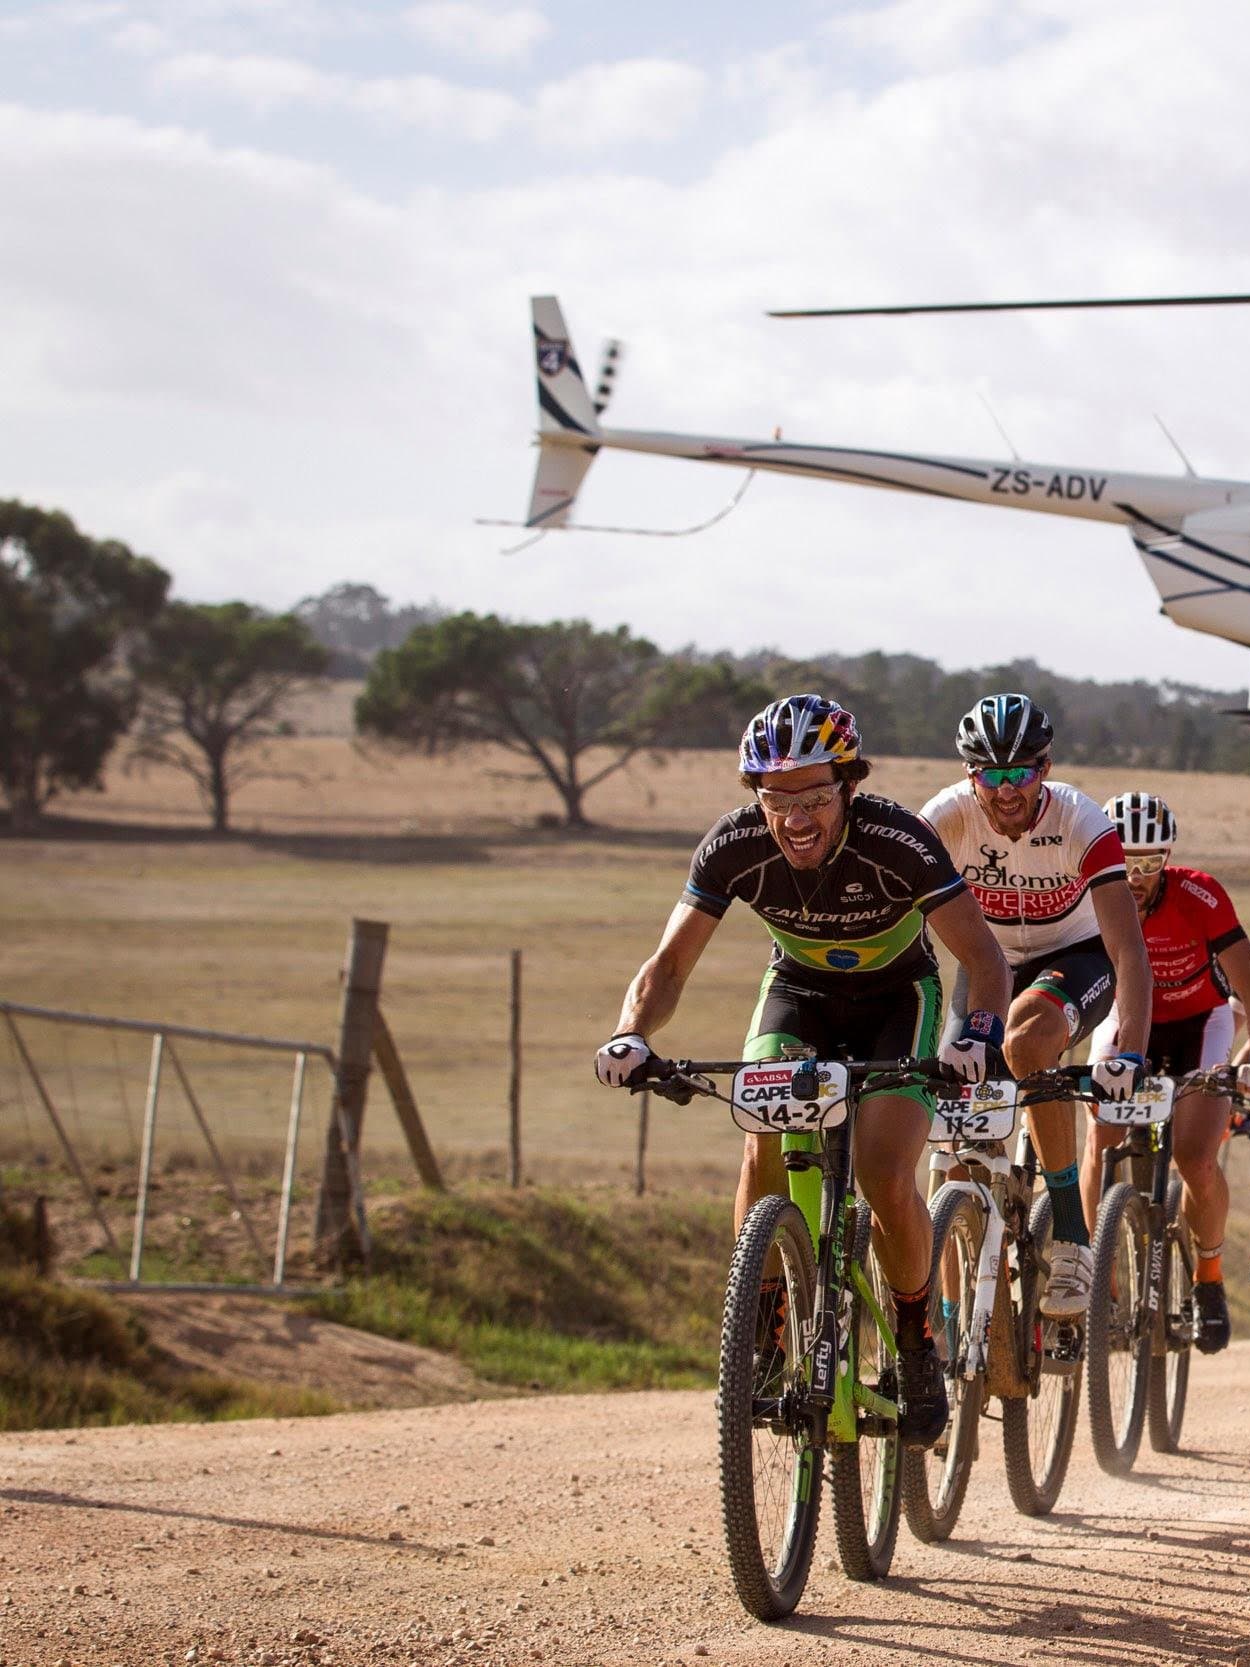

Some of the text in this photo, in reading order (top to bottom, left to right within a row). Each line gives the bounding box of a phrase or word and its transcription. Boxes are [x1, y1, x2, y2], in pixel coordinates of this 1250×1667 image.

[991, 467, 1108, 502] ZS-ADV
[970, 880, 1084, 911] UPERBIKE
[764, 1073, 788, 1082] ABSA
[740, 1083, 839, 1102] CAPE IC
[757, 1102, 821, 1125] 14-2
[937, 1101, 971, 1114] APE
[1114, 1105, 1152, 1120] 17-1
[945, 1115, 990, 1135] 11-2
[1148, 1239, 1164, 1311] DT SWISS
[813, 1339, 832, 1391] Lefty
